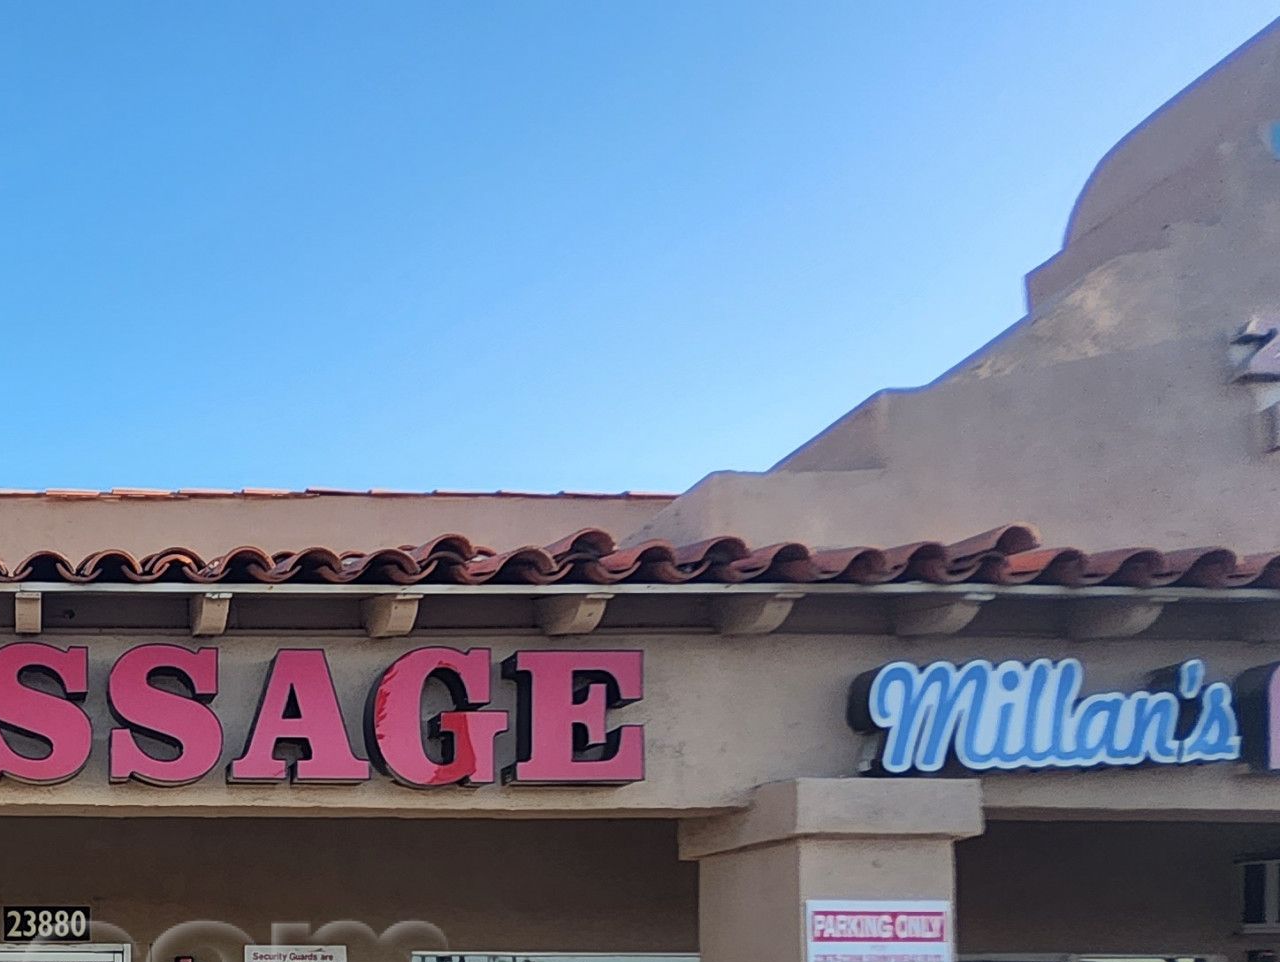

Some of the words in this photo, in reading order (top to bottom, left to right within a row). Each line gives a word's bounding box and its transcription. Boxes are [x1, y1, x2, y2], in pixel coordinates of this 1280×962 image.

[869, 658, 1241, 772] Millan's
[7, 910, 87, 938] 23880
[814, 915, 894, 938] PARKING
[895, 915, 943, 938] ONLY
[252, 952, 287, 962] Security
[289, 952, 318, 961] Guards
